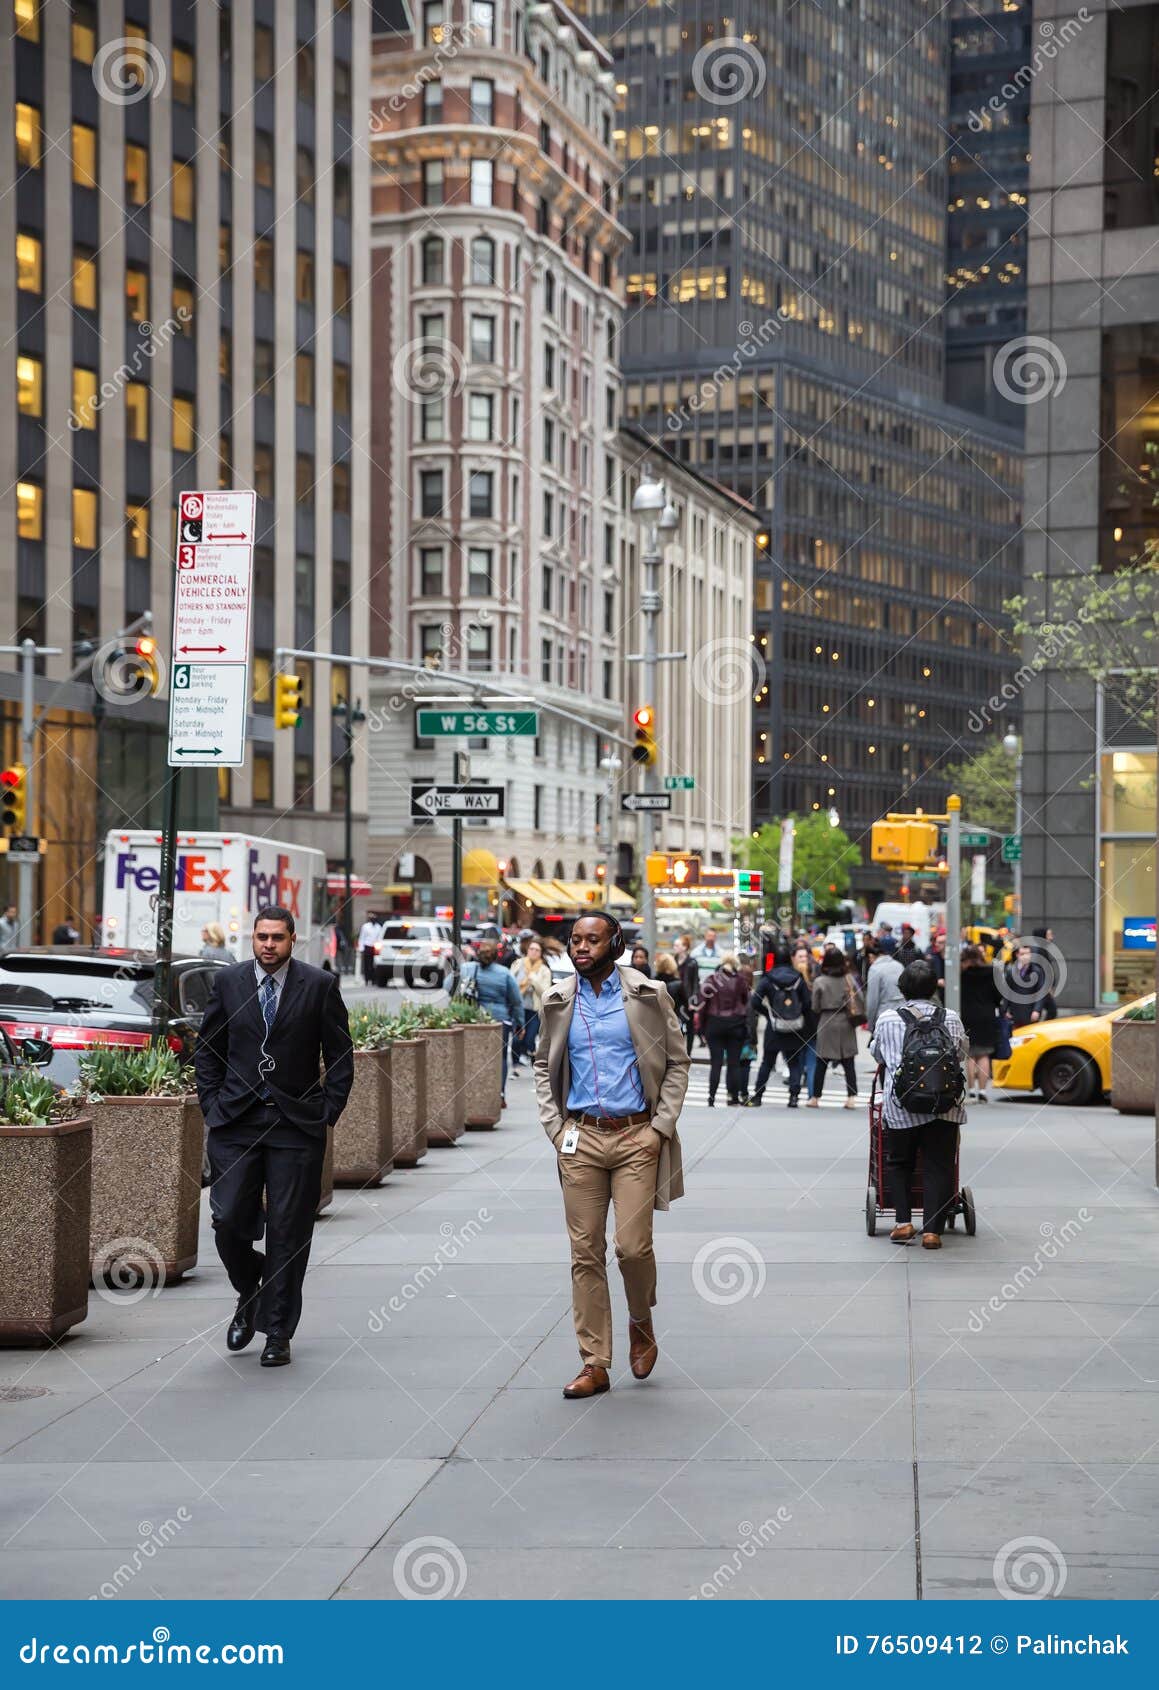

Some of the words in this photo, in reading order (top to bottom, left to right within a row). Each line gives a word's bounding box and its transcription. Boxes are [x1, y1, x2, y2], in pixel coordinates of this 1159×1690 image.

[181, 546, 194, 568] 3
[180, 575, 239, 585] COMMERCIAL
[180, 587, 222, 597] VEHICLES
[224, 587, 247, 597] ONLY
[216, 602, 247, 610] STANDING
[178, 617, 205, 625] Monday
[211, 616, 232, 625] Friday
[175, 666, 188, 688] 6
[175, 696, 201, 705] Monday
[207, 696, 229, 704] Friday
[195, 705, 224, 714] Midnight
[174, 719, 204, 728] Saturday
[441, 716, 456, 732] W
[463, 716, 488, 732] 56
[495, 716, 516, 732] St
[195, 729, 224, 738] Midnight
[424, 795, 451, 808] ONE
[465, 795, 492, 808] WAY
[116, 853, 231, 892] FedEx
[248, 849, 302, 919] FedEx
